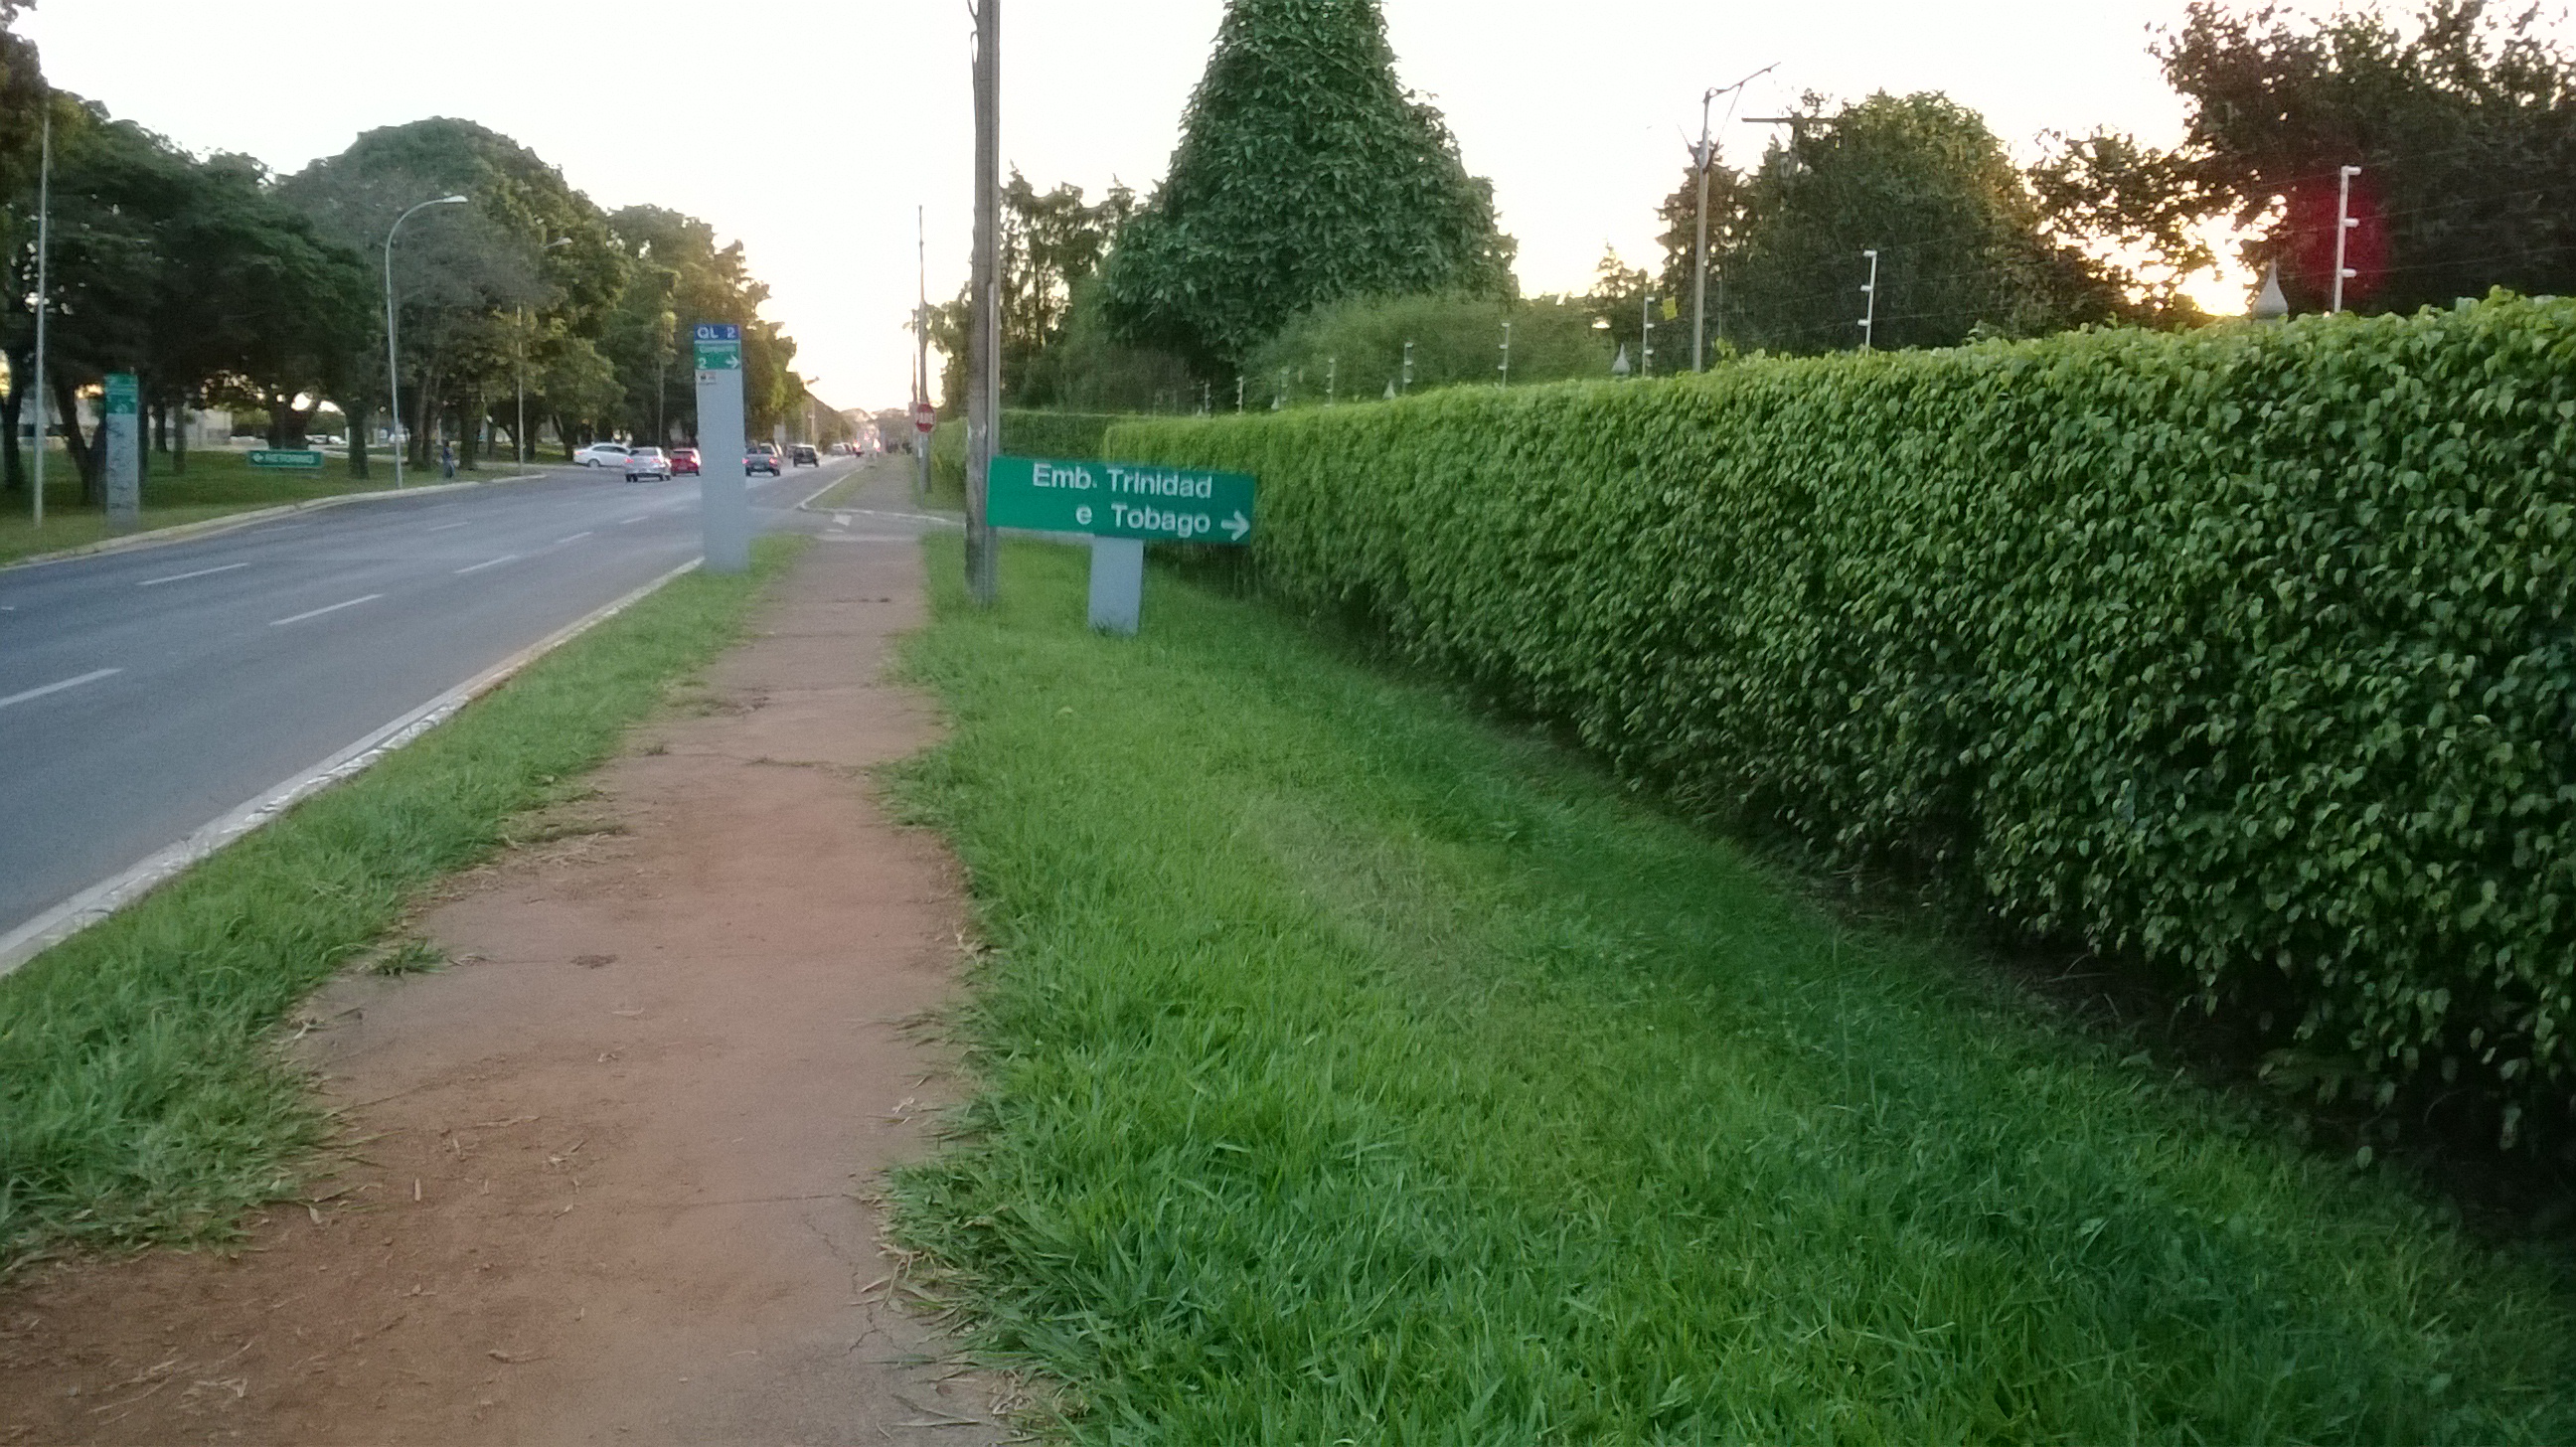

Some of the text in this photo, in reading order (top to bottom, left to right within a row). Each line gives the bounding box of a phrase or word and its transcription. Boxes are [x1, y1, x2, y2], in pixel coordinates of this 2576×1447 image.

[697, 326, 719, 339] QL
[698, 357, 707, 369] 2
[1032, 462, 1212, 499] Emb. Trinidad
[1075, 502, 1211, 539] e Tobago
